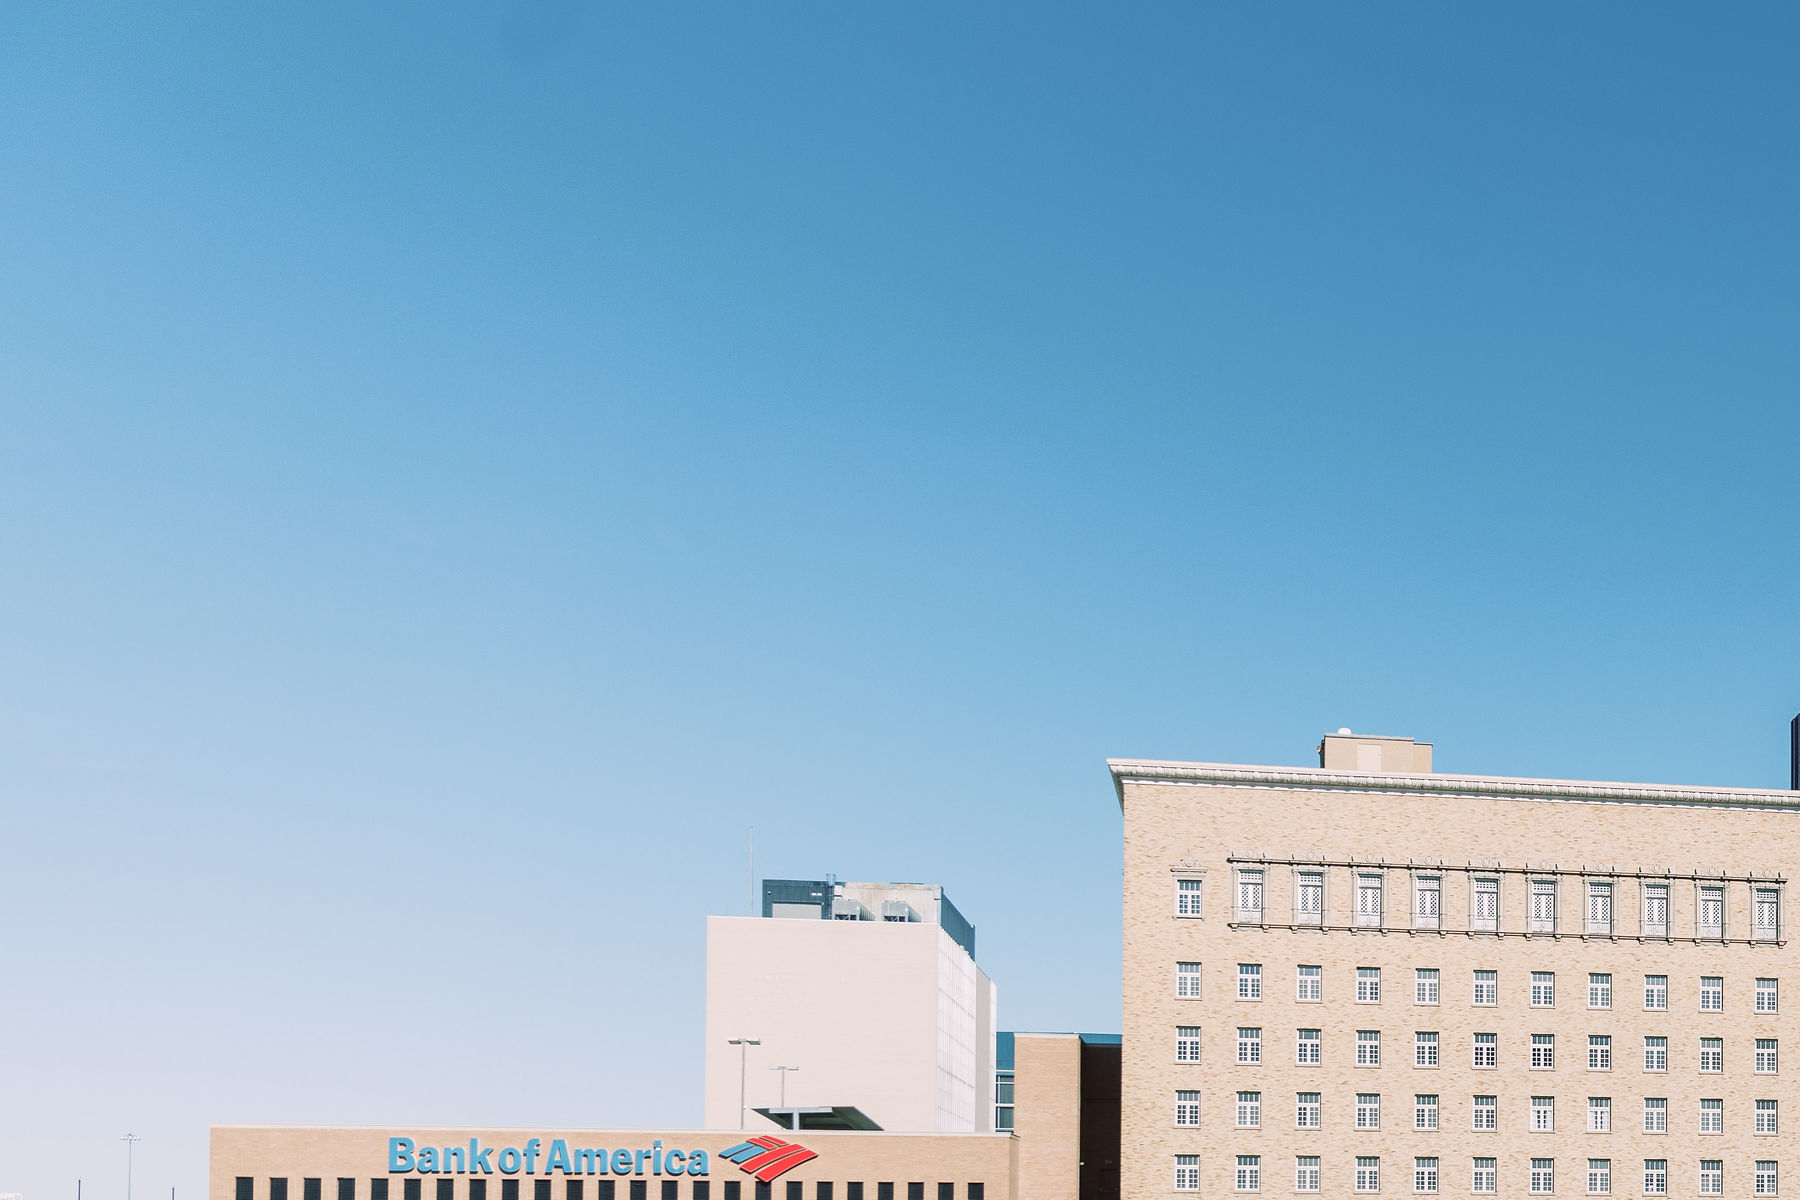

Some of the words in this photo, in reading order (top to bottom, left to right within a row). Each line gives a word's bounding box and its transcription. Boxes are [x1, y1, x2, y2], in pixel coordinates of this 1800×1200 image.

[388, 1137, 494, 1174] Bank
[498, 1138, 541, 1174] of
[544, 1138, 710, 1176] America
